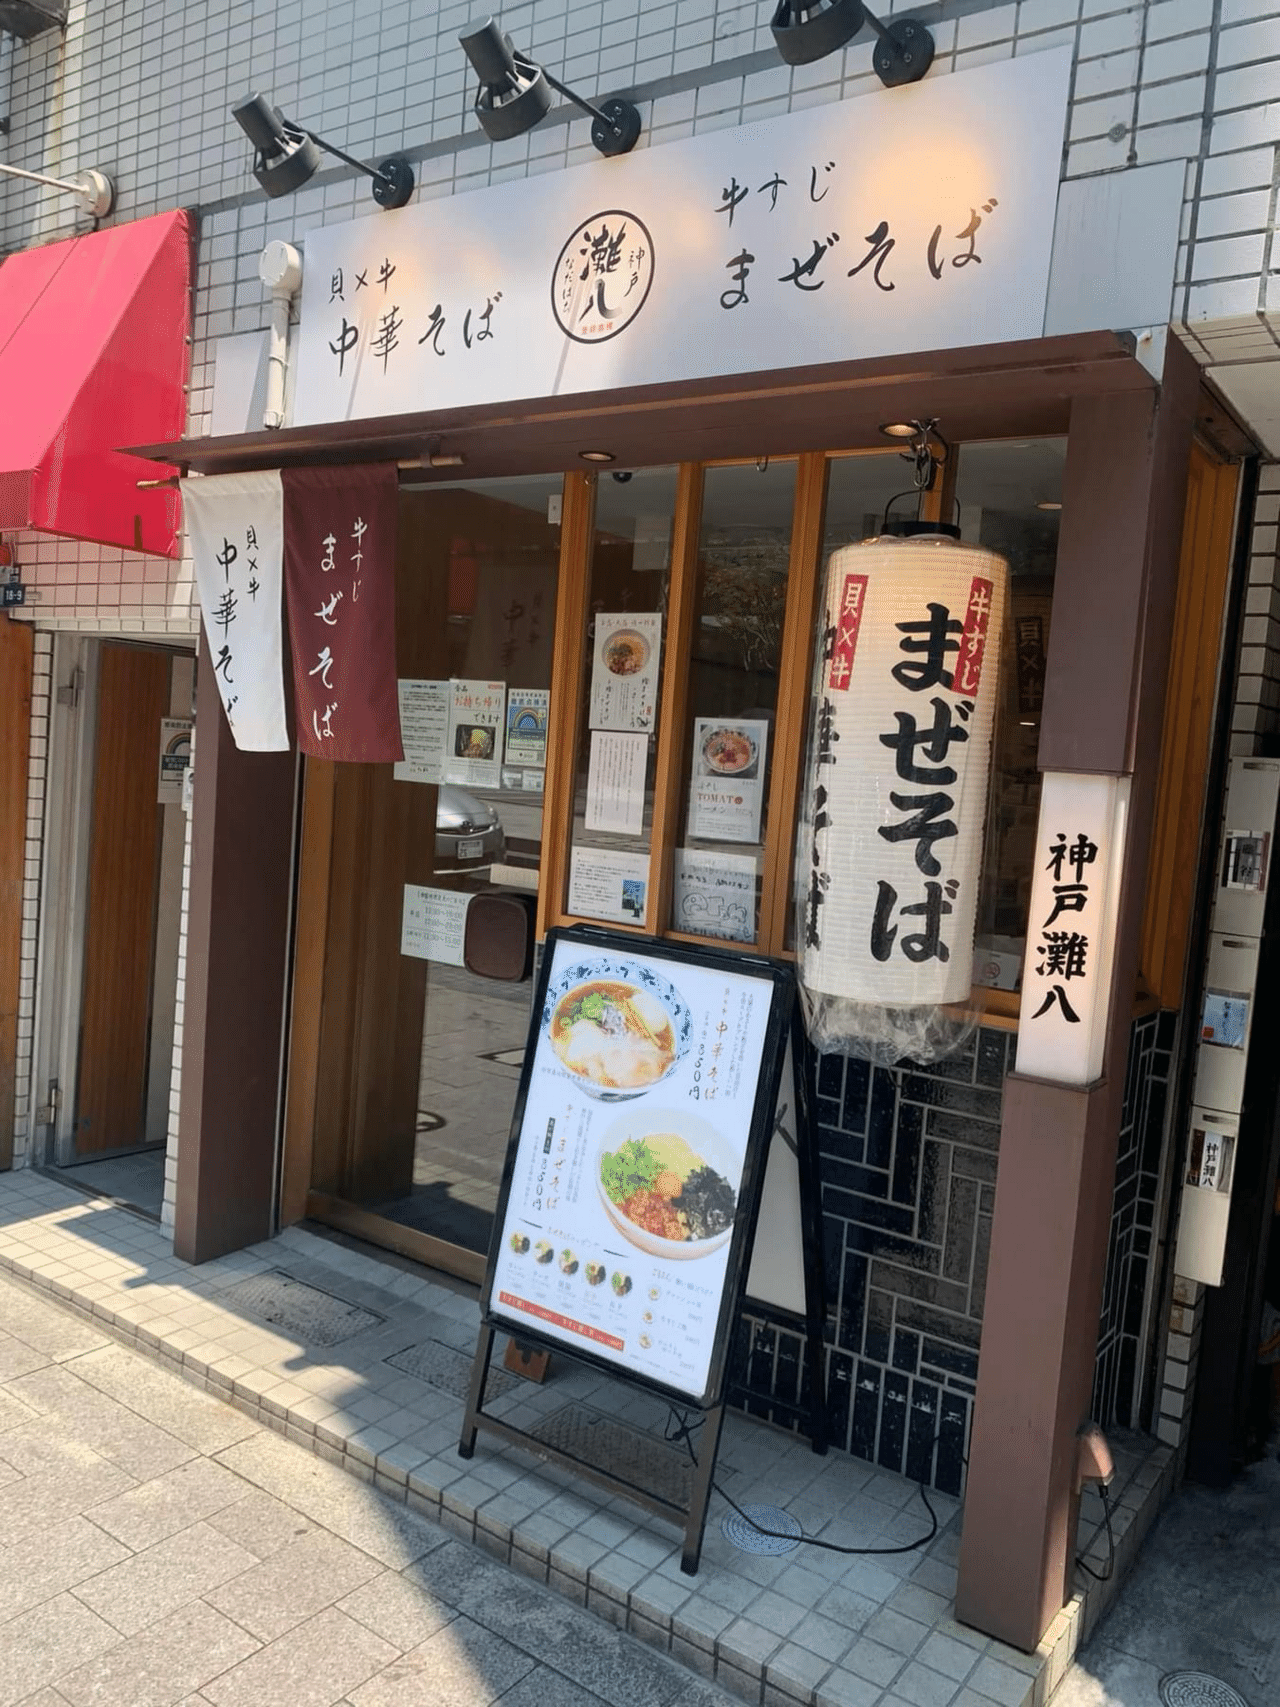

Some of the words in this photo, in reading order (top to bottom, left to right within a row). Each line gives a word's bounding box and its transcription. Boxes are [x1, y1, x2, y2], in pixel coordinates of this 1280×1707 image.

[715, 161, 836, 228] 牛すじ
[579, 221, 627, 324] 灘八
[624, 246, 646, 298] 神戸
[720, 198, 999, 310] まぜそば
[328, 291, 503, 377] 中華そば
[351, 517, 368, 602] 牛すじ
[309, 532, 344, 741] まぜそば
[960, 587, 989, 692] 牛すじ
[870, 602, 974, 963] まぜそば
[1031, 833, 1098, 1023] 神戸灘八
